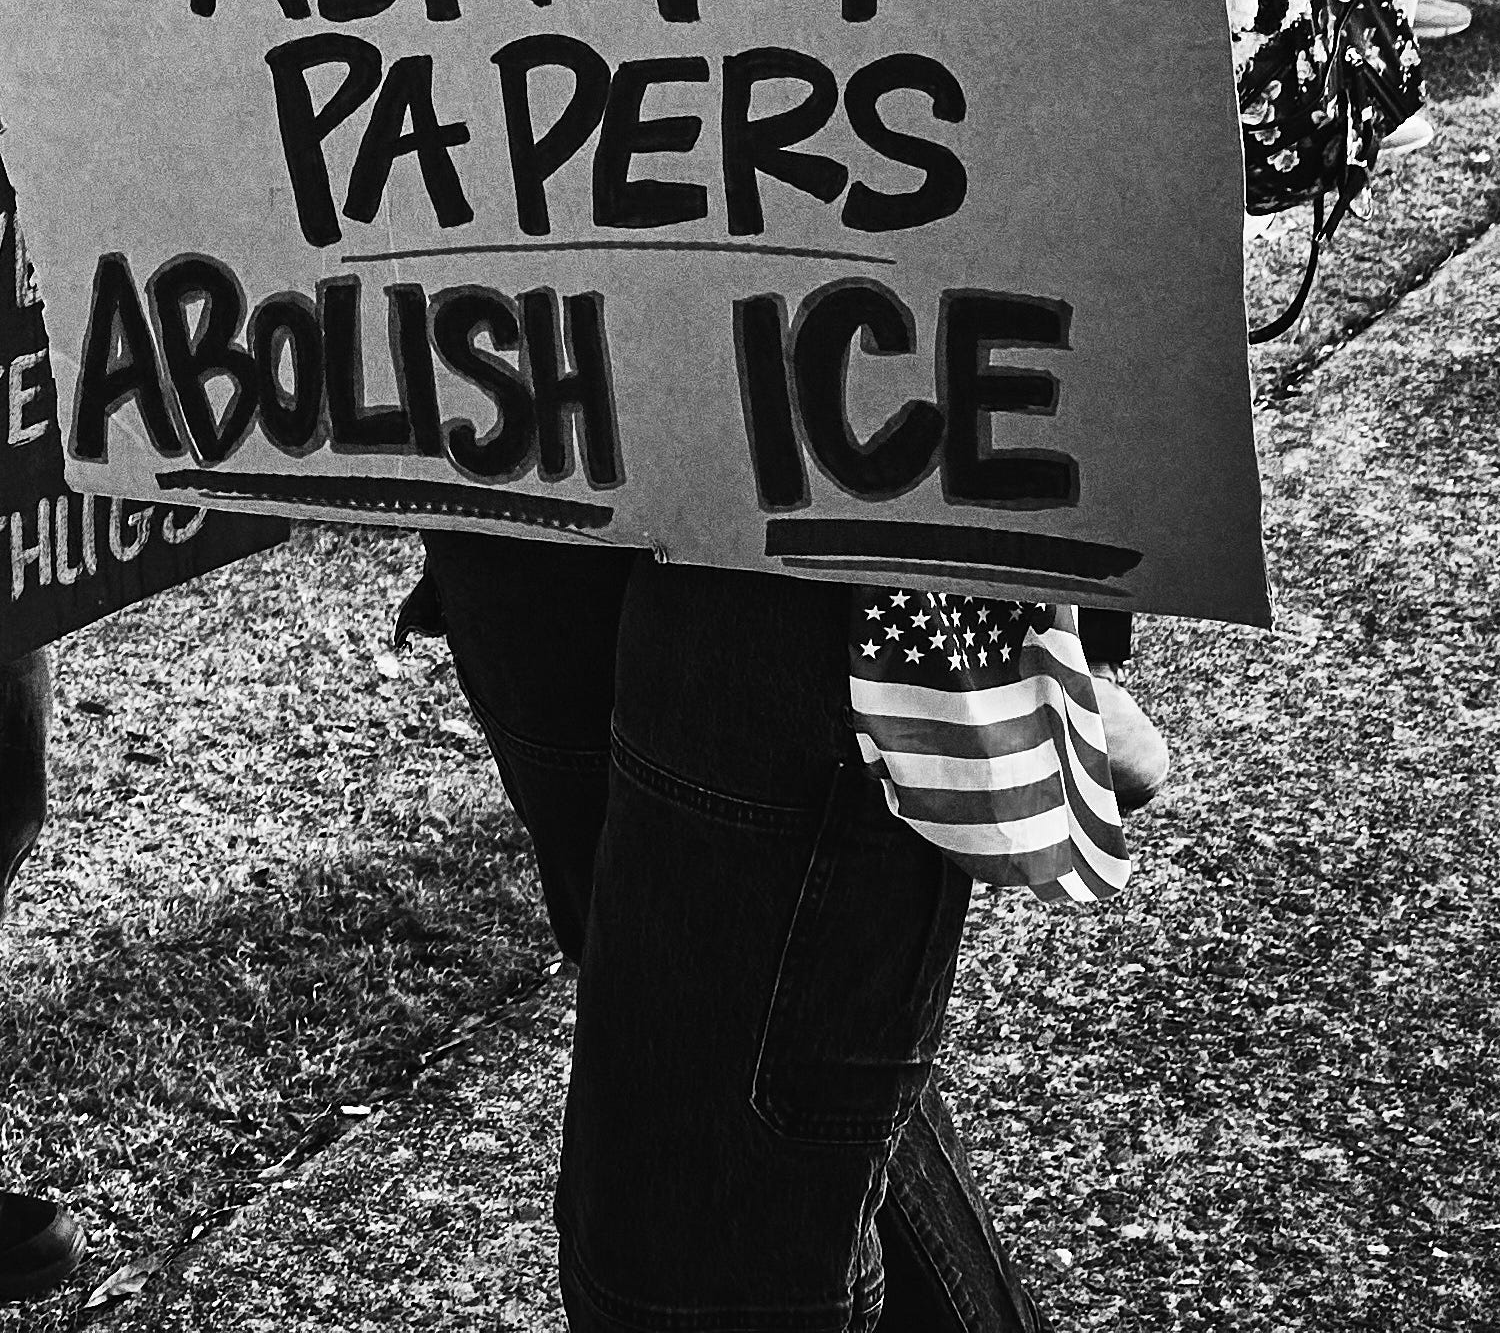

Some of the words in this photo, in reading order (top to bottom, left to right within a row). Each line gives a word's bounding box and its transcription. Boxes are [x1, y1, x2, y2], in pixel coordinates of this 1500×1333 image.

[265, 32, 968, 247] PAPERS
[68, 252, 625, 491] ABOLISH
[731, 274, 1081, 511] ICE
